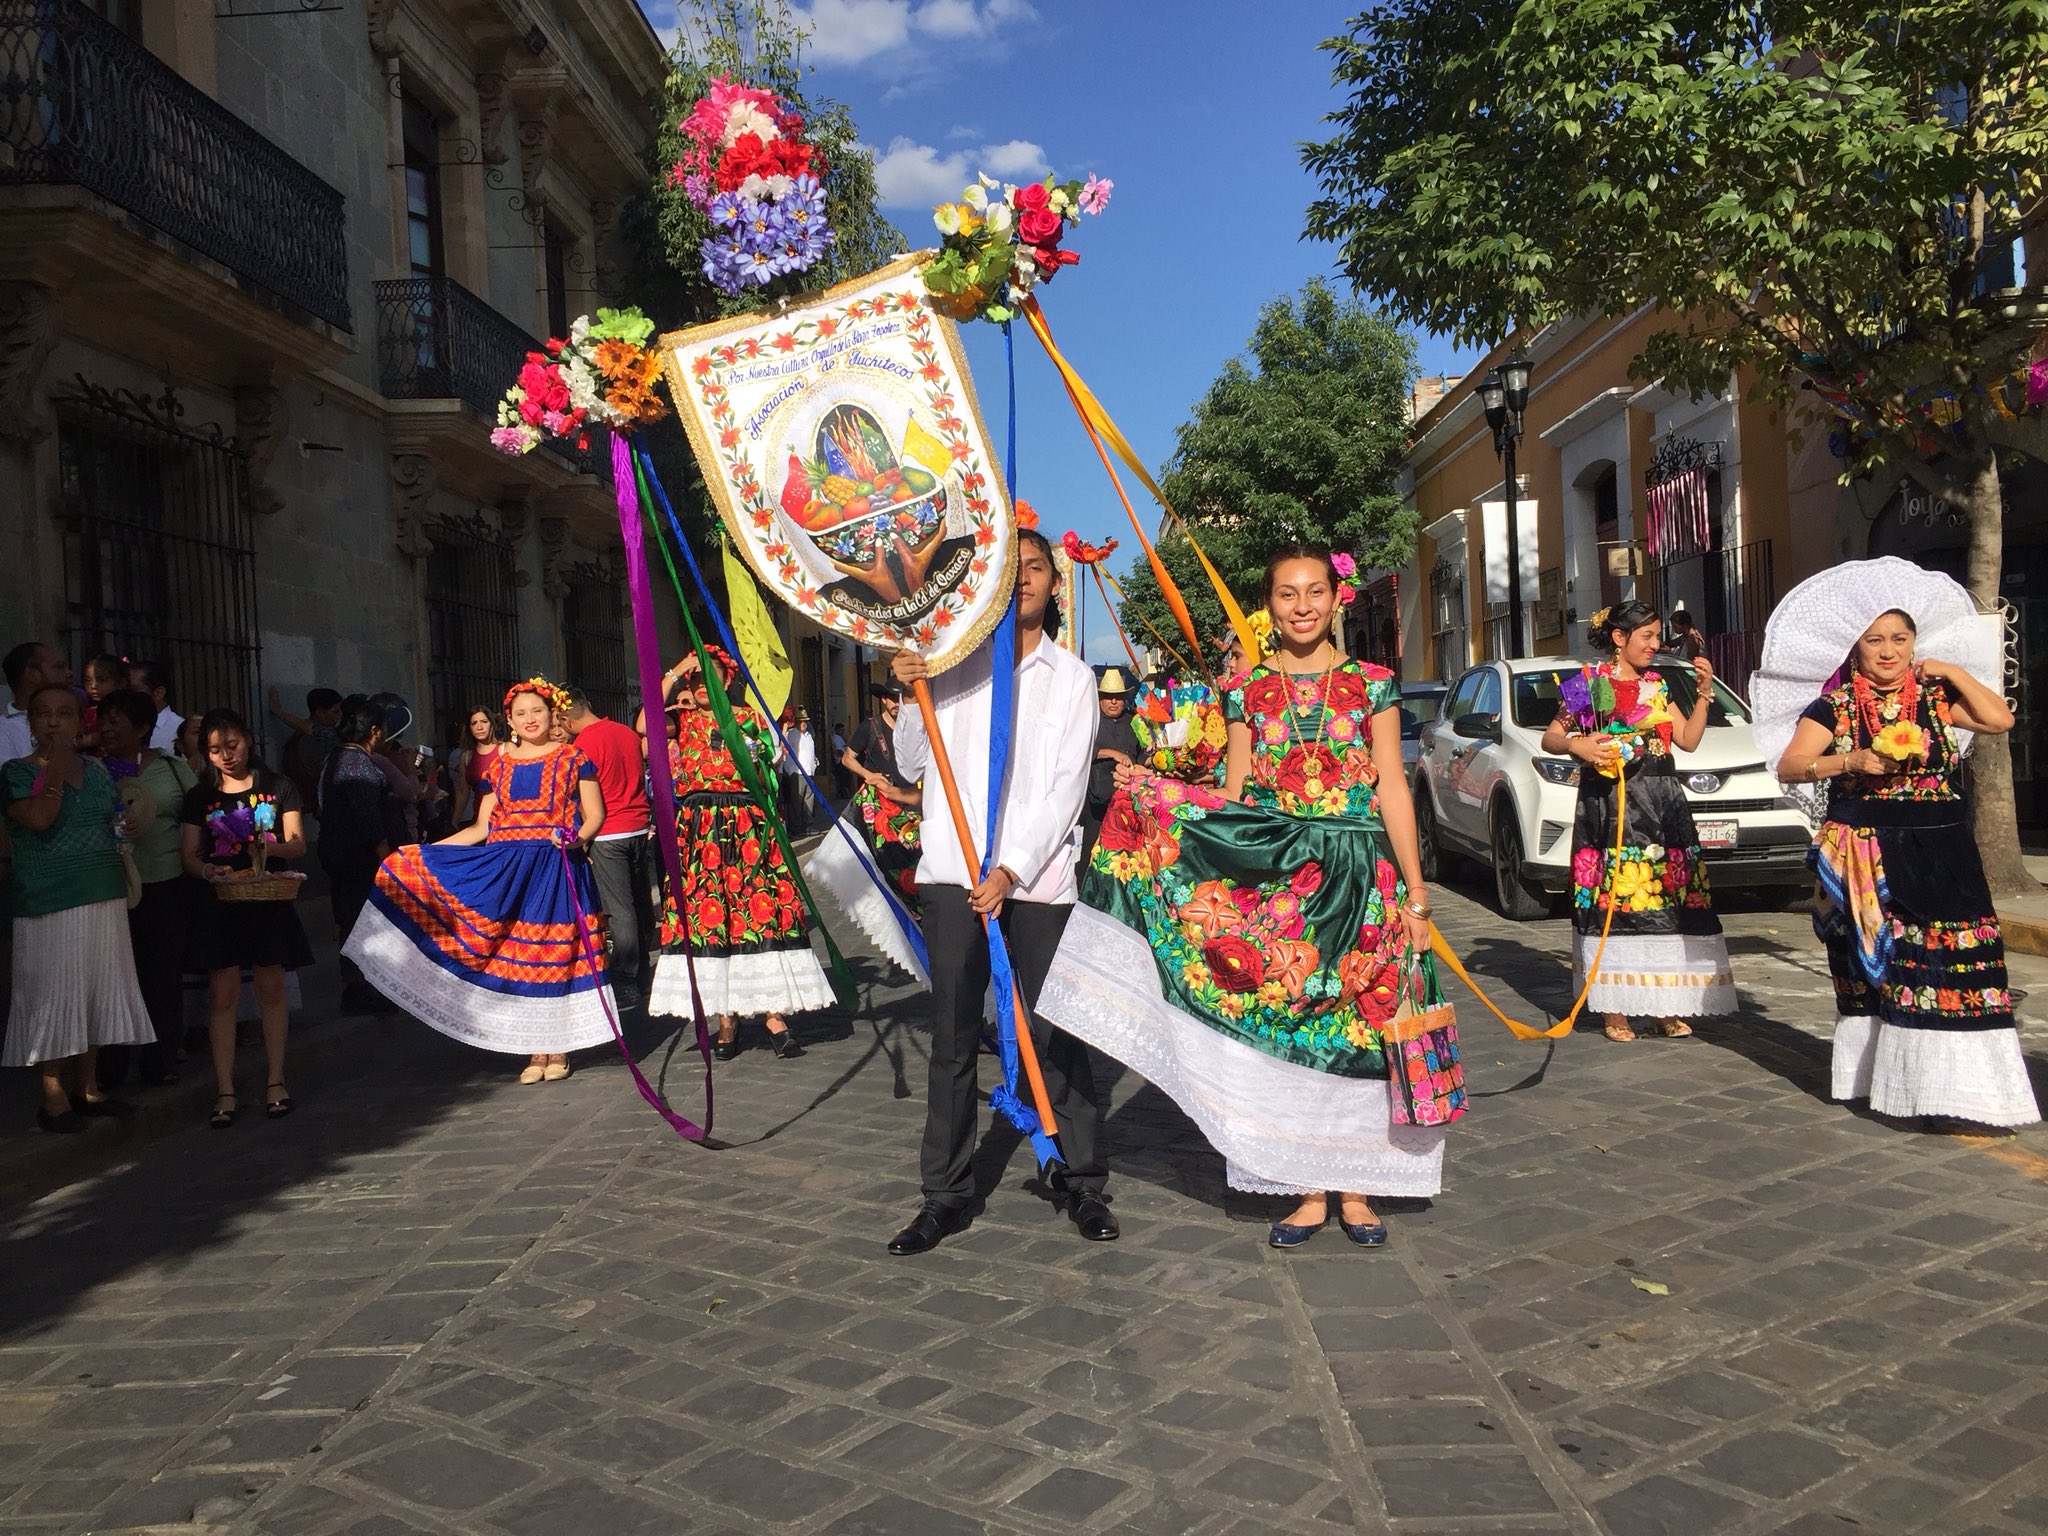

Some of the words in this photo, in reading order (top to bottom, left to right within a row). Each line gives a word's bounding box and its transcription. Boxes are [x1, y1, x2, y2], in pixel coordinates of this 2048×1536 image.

[728, 370, 744, 385] Por
[744, 380, 805, 440] Asociación
[821, 359, 835, 373] de
[848, 350, 915, 380] Juchitecos
[893, 606, 907, 617] en
[905, 599, 917, 613] la
[928, 583, 939, 597] de
[935, 549, 970, 587] Oaxaca
